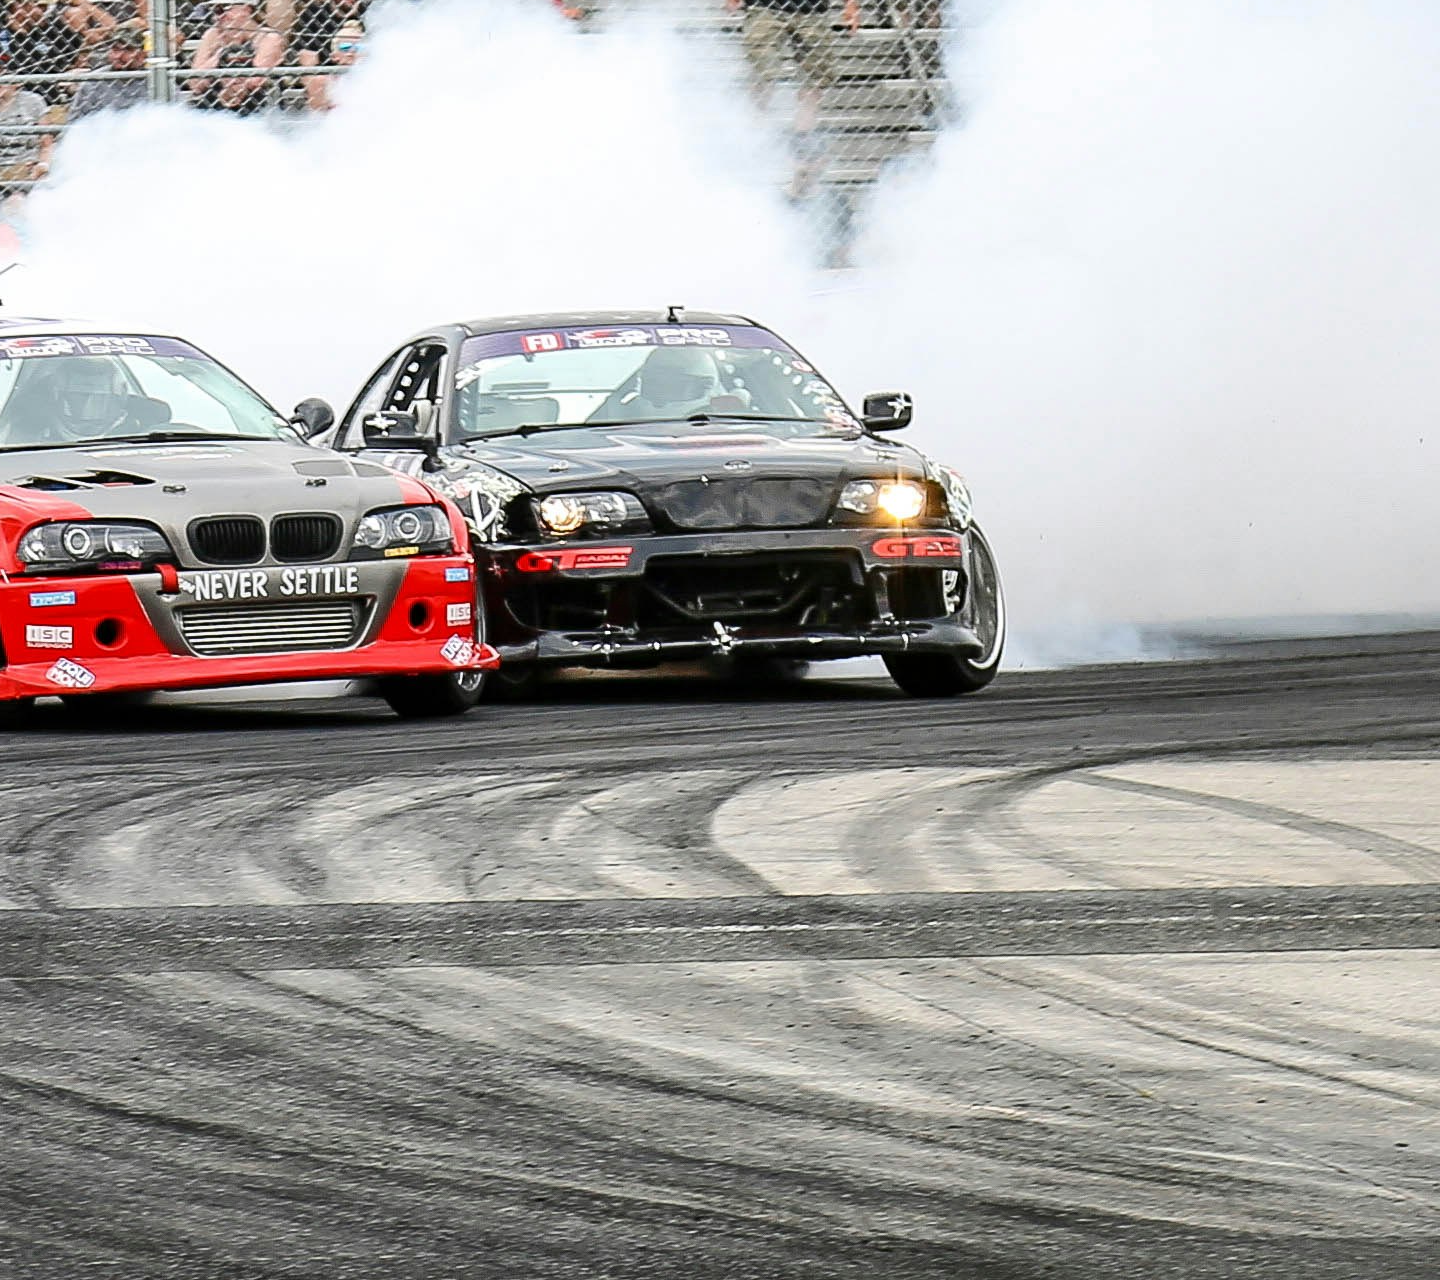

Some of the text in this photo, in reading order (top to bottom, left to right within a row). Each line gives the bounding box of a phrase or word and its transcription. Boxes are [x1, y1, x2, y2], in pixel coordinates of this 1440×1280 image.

[656, 328, 729, 338] PRO
[77, 336, 150, 346] PRO
[525, 335, 558, 352] FD
[577, 554, 629, 562] RADIAL
[195, 566, 359, 601] NEVER SETTLE
